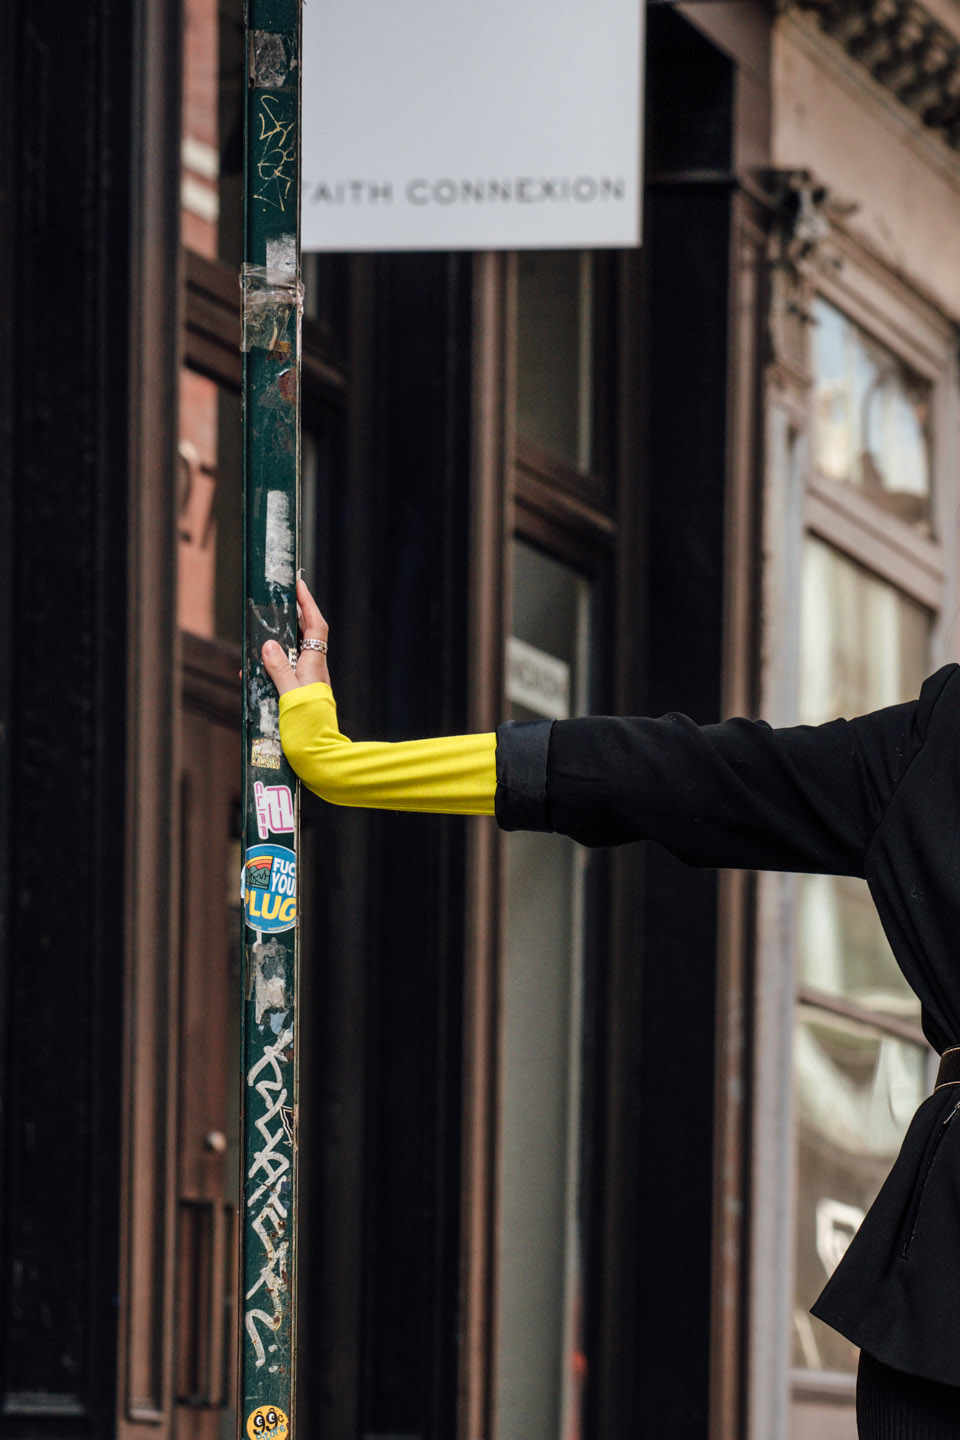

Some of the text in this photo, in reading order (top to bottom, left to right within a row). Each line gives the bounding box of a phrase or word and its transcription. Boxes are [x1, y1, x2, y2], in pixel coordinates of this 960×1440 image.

[302, 175, 625, 207] AITH CONNEXION
[273, 857, 297, 877] FUC
